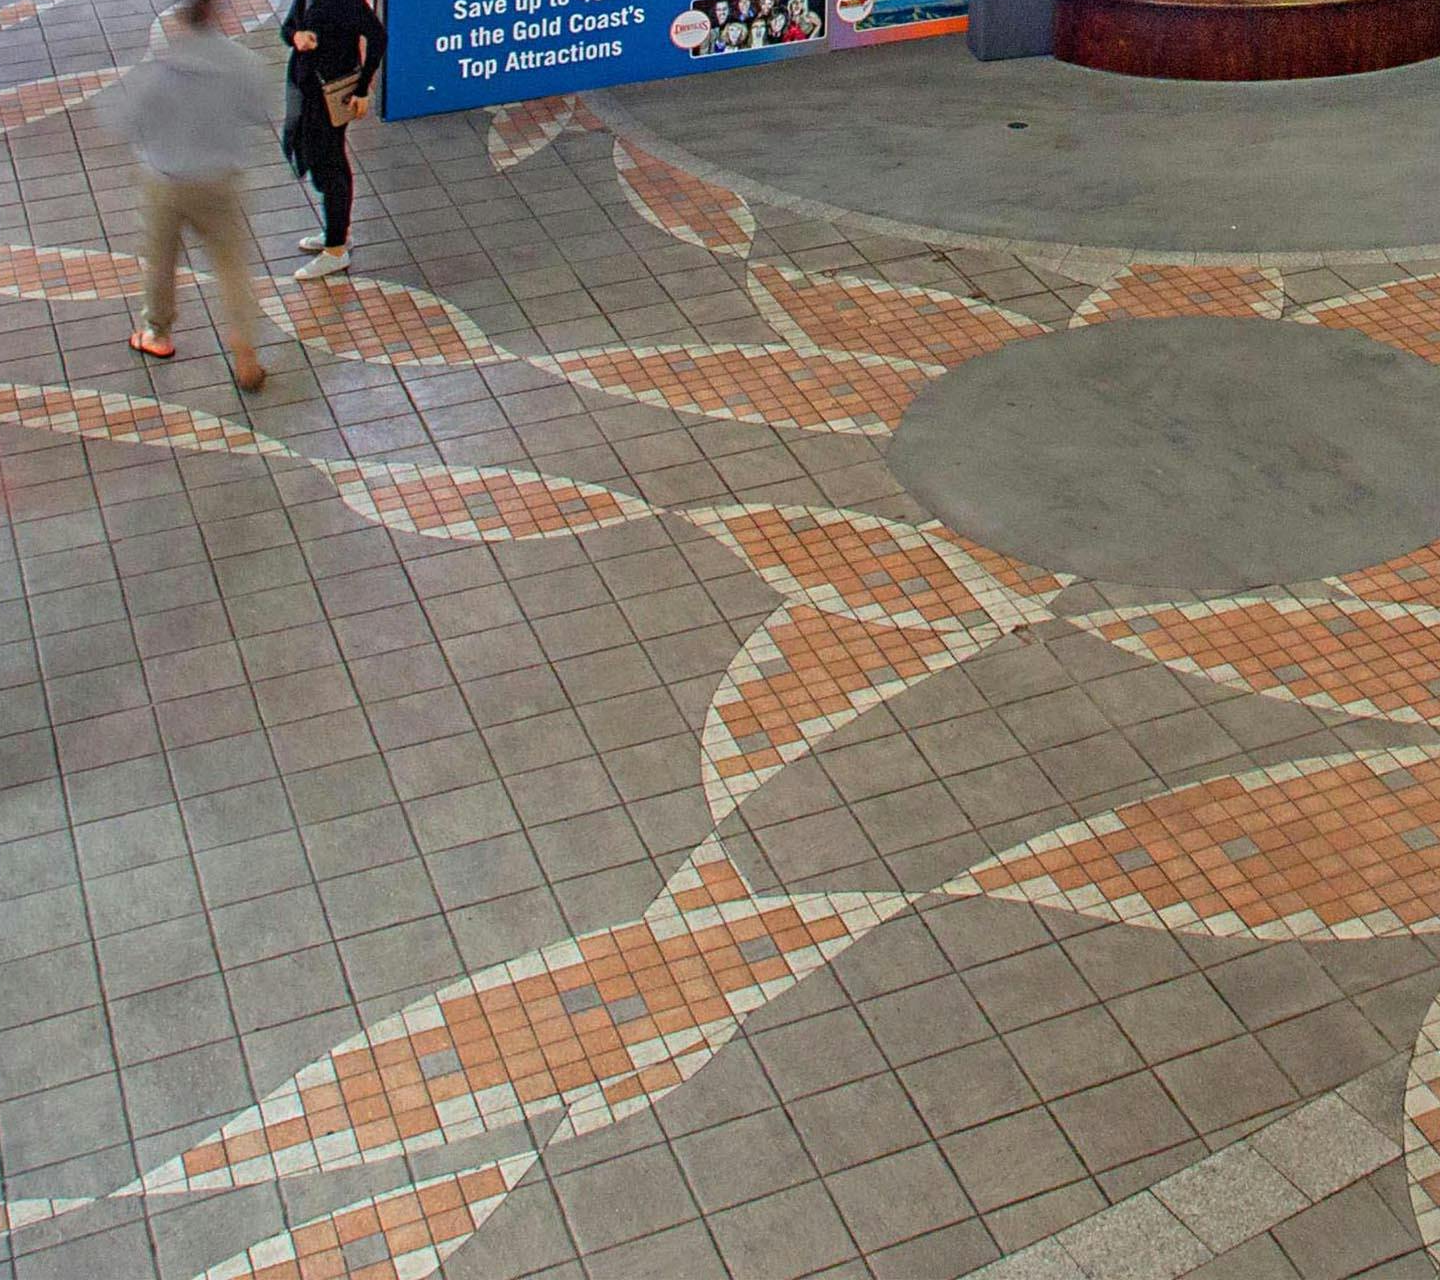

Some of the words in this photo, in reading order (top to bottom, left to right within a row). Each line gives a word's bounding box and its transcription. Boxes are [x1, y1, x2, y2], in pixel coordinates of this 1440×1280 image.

[435, 34, 462, 52] on
[470, 27, 504, 48] the
[513, 16, 561, 41] Gold
[569, 5, 645, 34] Coast's
[458, 57, 498, 80] Top
[505, 40, 622, 72] Attractions
